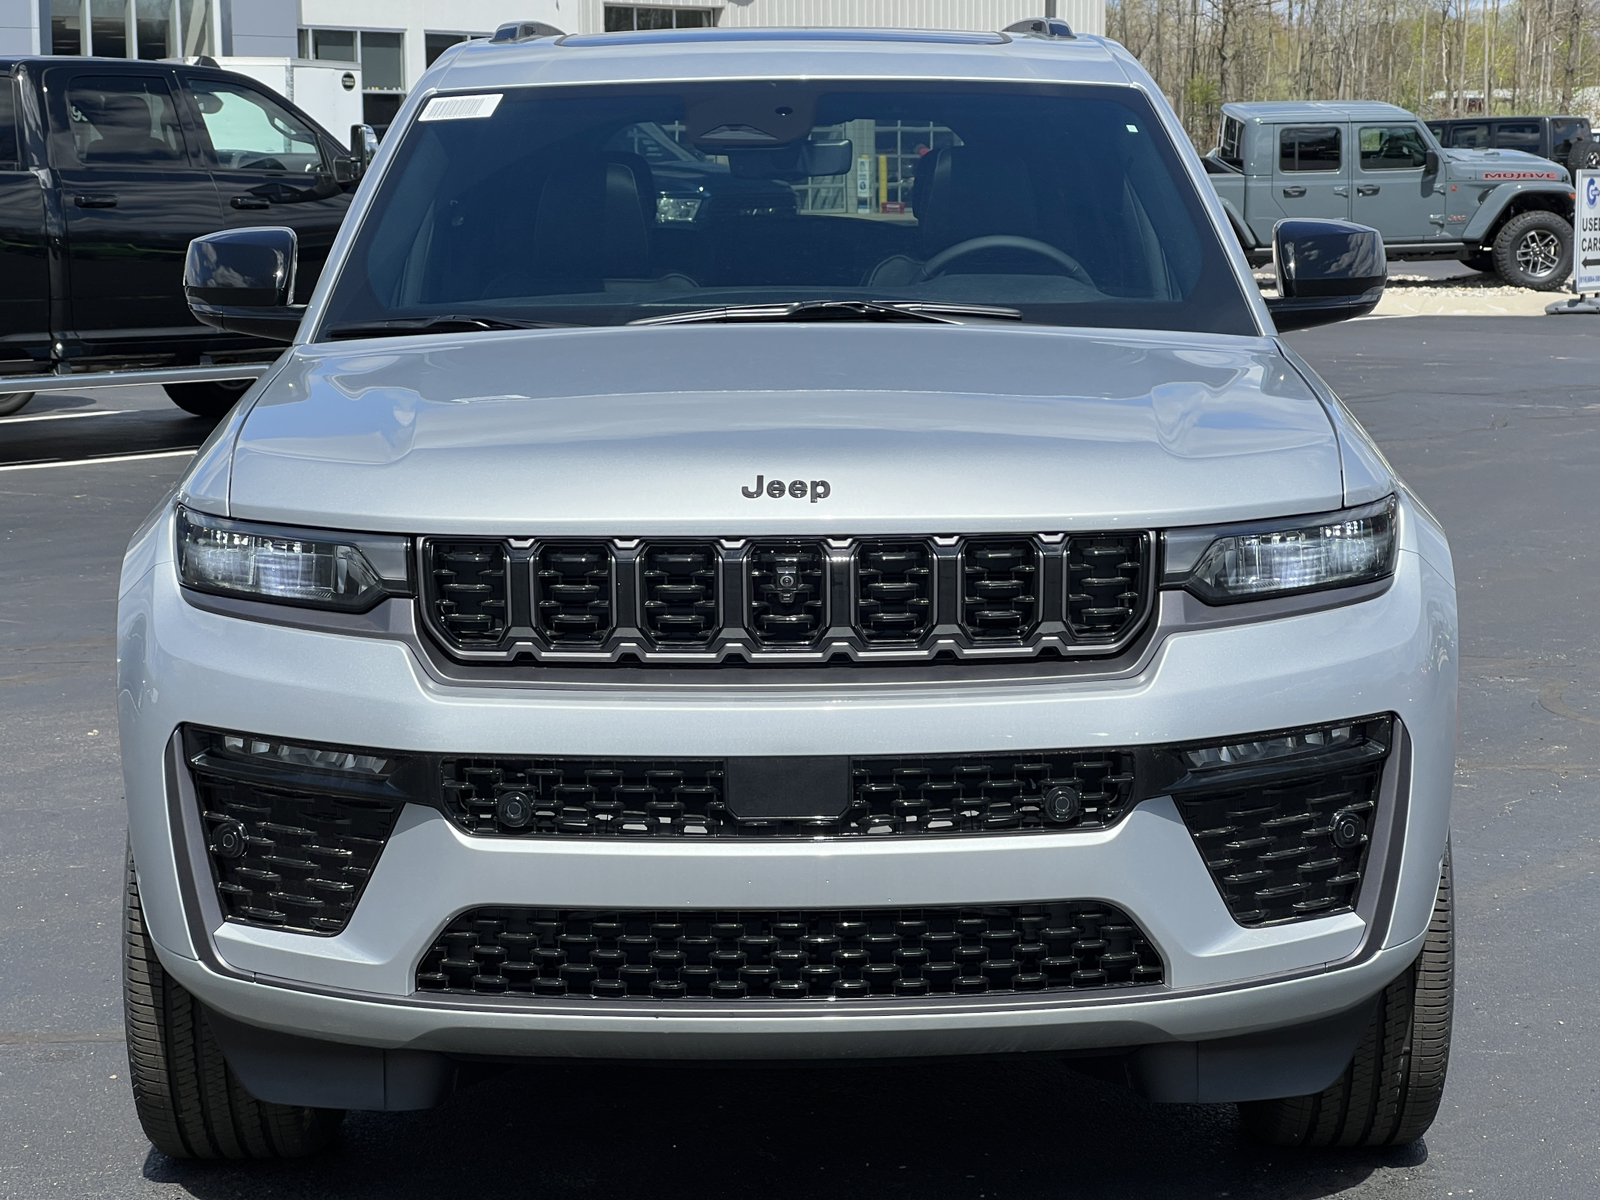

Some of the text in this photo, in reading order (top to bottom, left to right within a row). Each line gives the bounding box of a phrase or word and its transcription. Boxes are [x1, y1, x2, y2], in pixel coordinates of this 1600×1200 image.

[1484, 172, 1557, 180] MOJAVE
[1582, 217, 1600, 232] USE
[1581, 237, 1600, 252] CAR
[741, 474, 831, 503] Jeep
